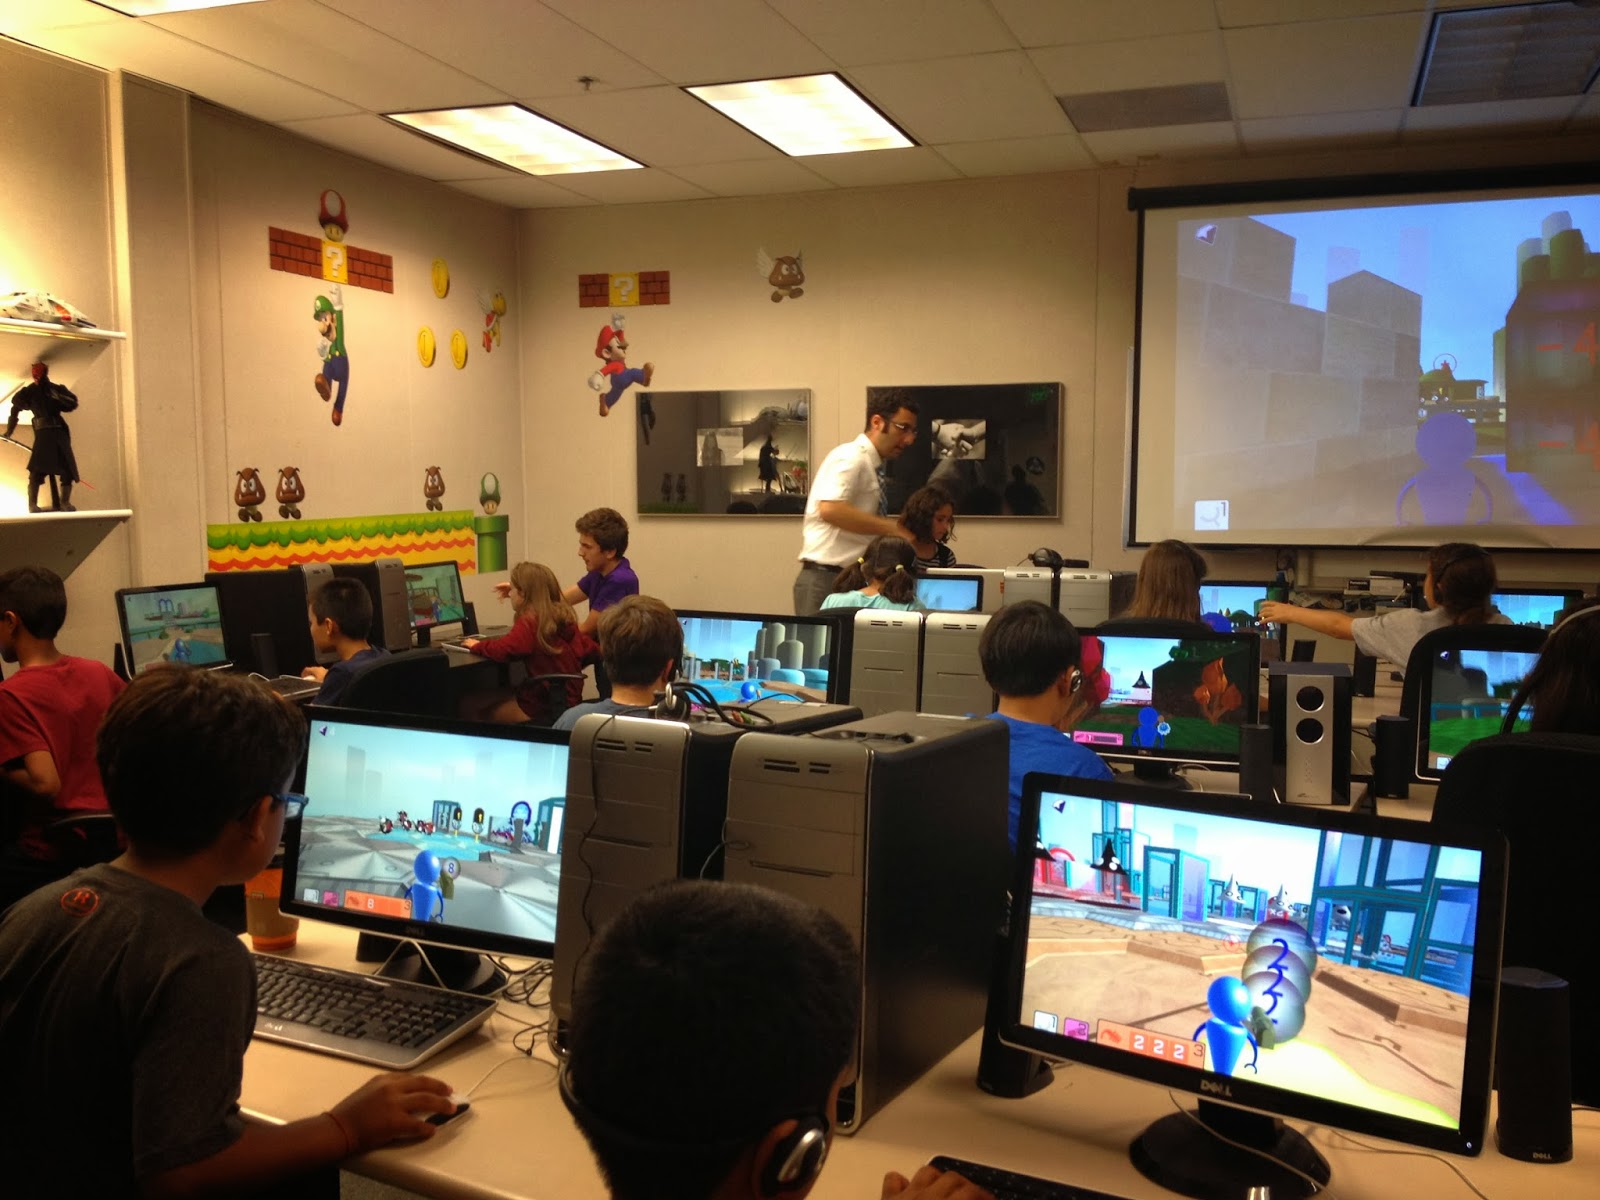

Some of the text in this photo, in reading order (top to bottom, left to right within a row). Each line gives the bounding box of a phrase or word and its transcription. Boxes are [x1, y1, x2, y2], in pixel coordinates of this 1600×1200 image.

[326, 246, 343, 278] ?
[614, 277, 634, 302] ?
[1220, 501, 1226, 517] 1
[448, 862, 455, 874] 8
[367, 898, 375, 909] 8
[1133, 1034, 1204, 1060] 2 2 2 3
[1200, 1079, 1233, 1097] DELL
[1532, 1152, 1552, 1160] DELL
